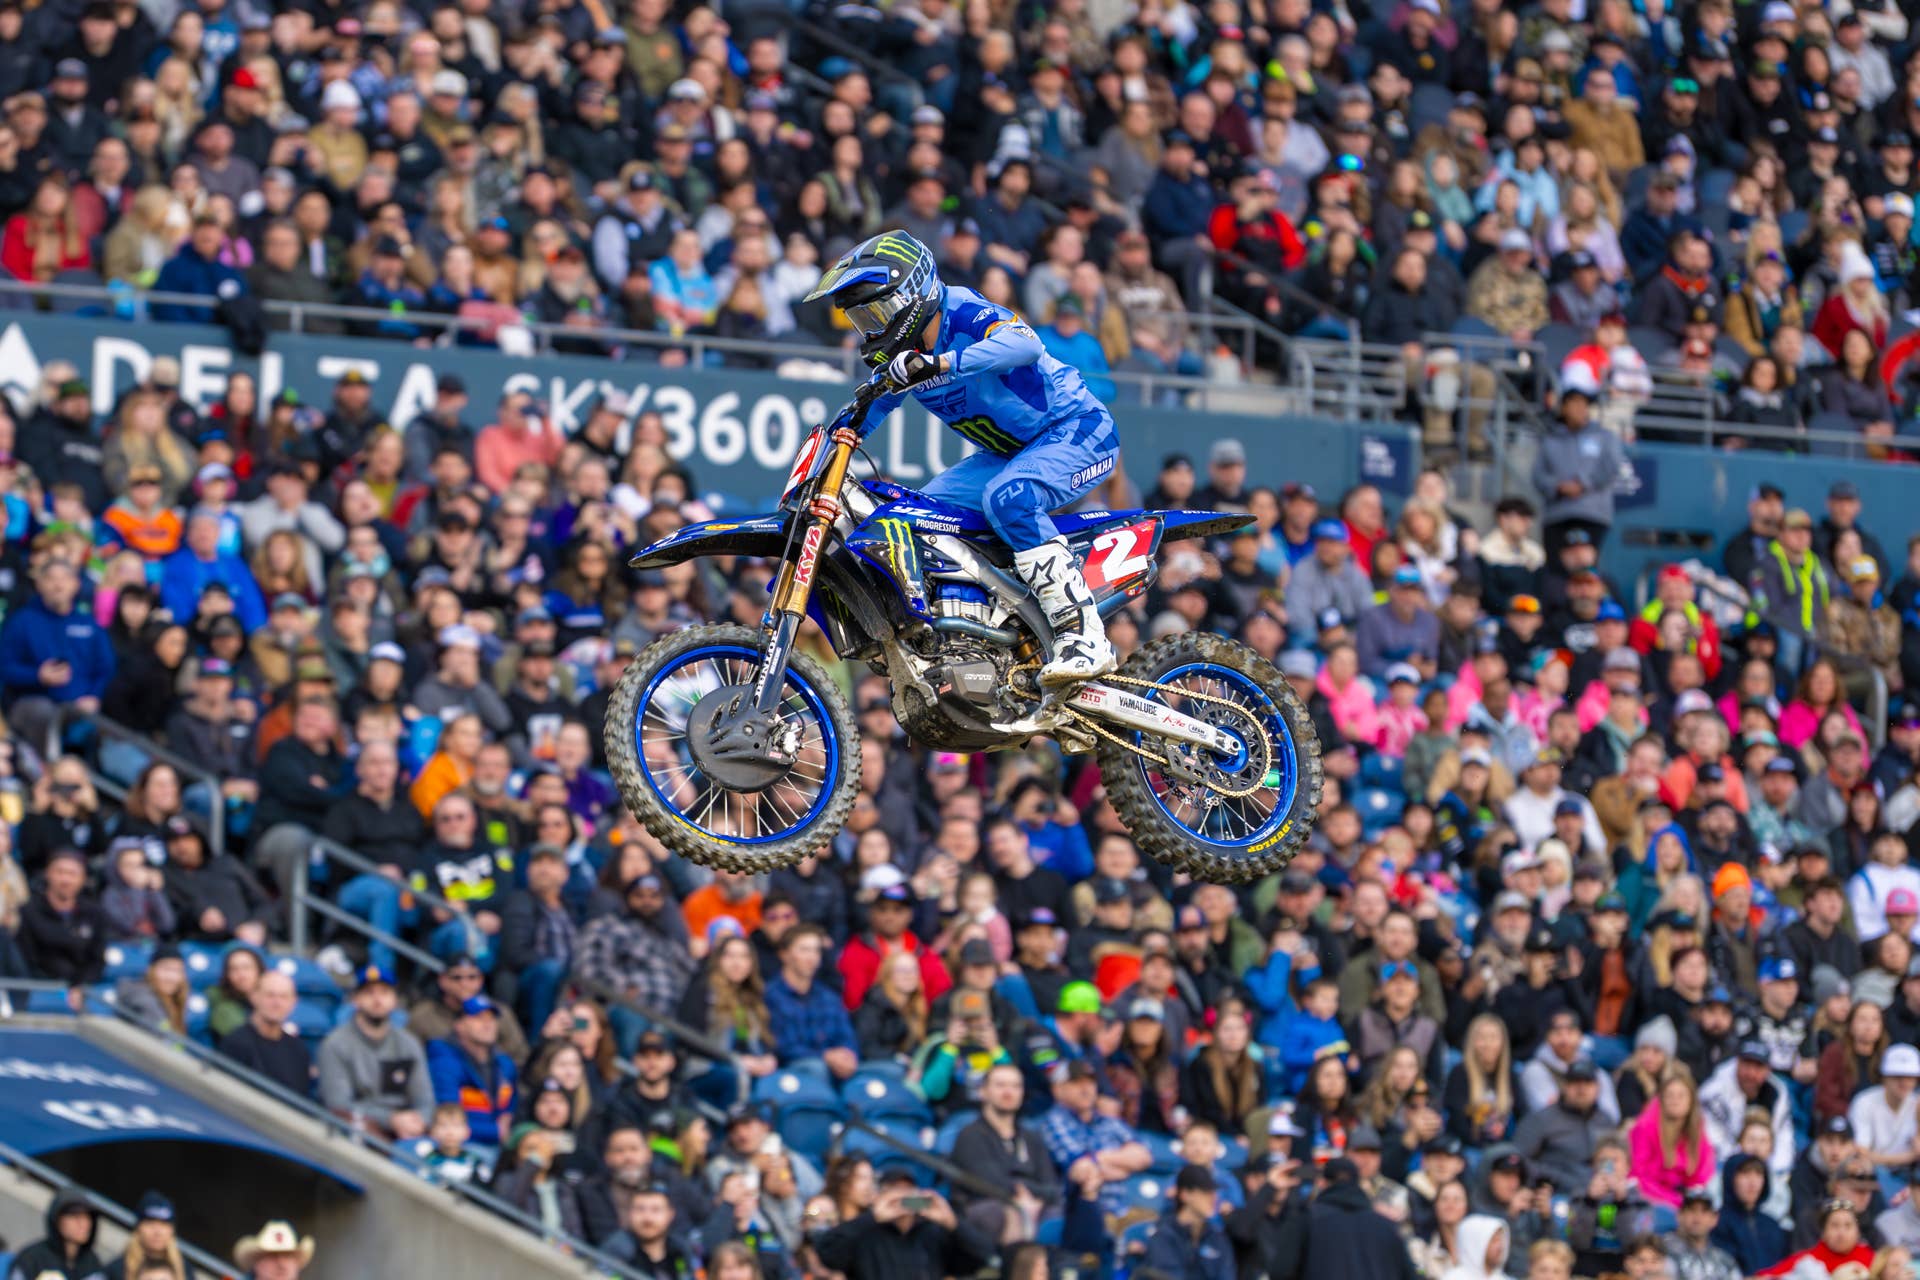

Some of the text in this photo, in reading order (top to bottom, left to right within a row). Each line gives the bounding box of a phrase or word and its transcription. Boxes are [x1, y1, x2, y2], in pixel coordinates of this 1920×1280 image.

[1080, 457, 1113, 483] YAMAHA
[997, 481, 1025, 507] FLY
[915, 518, 961, 533] PROGRESSIVE
[1079, 511, 1111, 520] YAMAHA
[794, 525, 822, 587] KYB
[1092, 529, 1148, 583] 2
[753, 629, 779, 698] DUNLOP
[1119, 695, 1158, 717] YAMALUBE
[1247, 823, 1291, 853] DUNLOP
